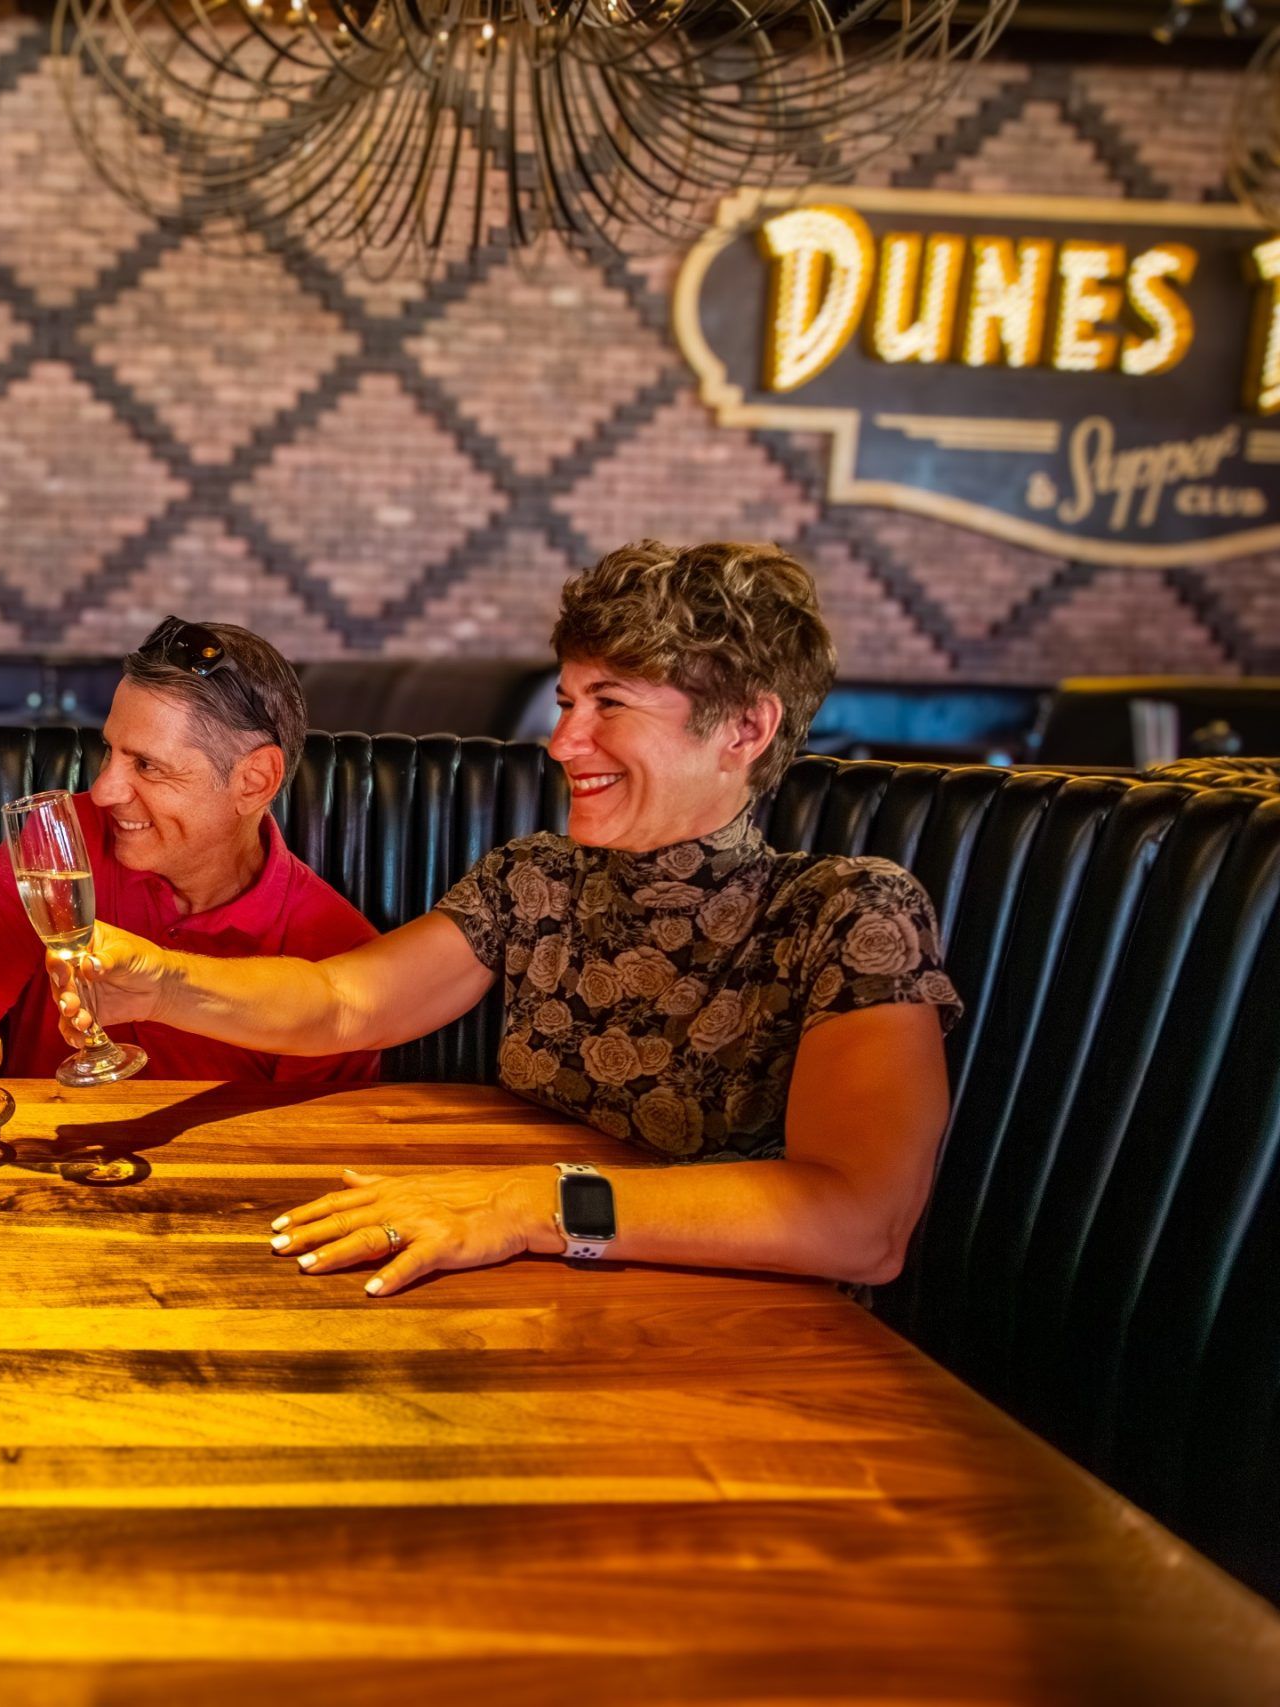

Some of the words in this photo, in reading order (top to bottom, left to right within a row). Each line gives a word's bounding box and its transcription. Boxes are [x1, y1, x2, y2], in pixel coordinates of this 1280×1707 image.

[761, 204, 1198, 392] DUNES
[1058, 415, 1240, 529] Supper
[1174, 485, 1266, 516] CLUB
